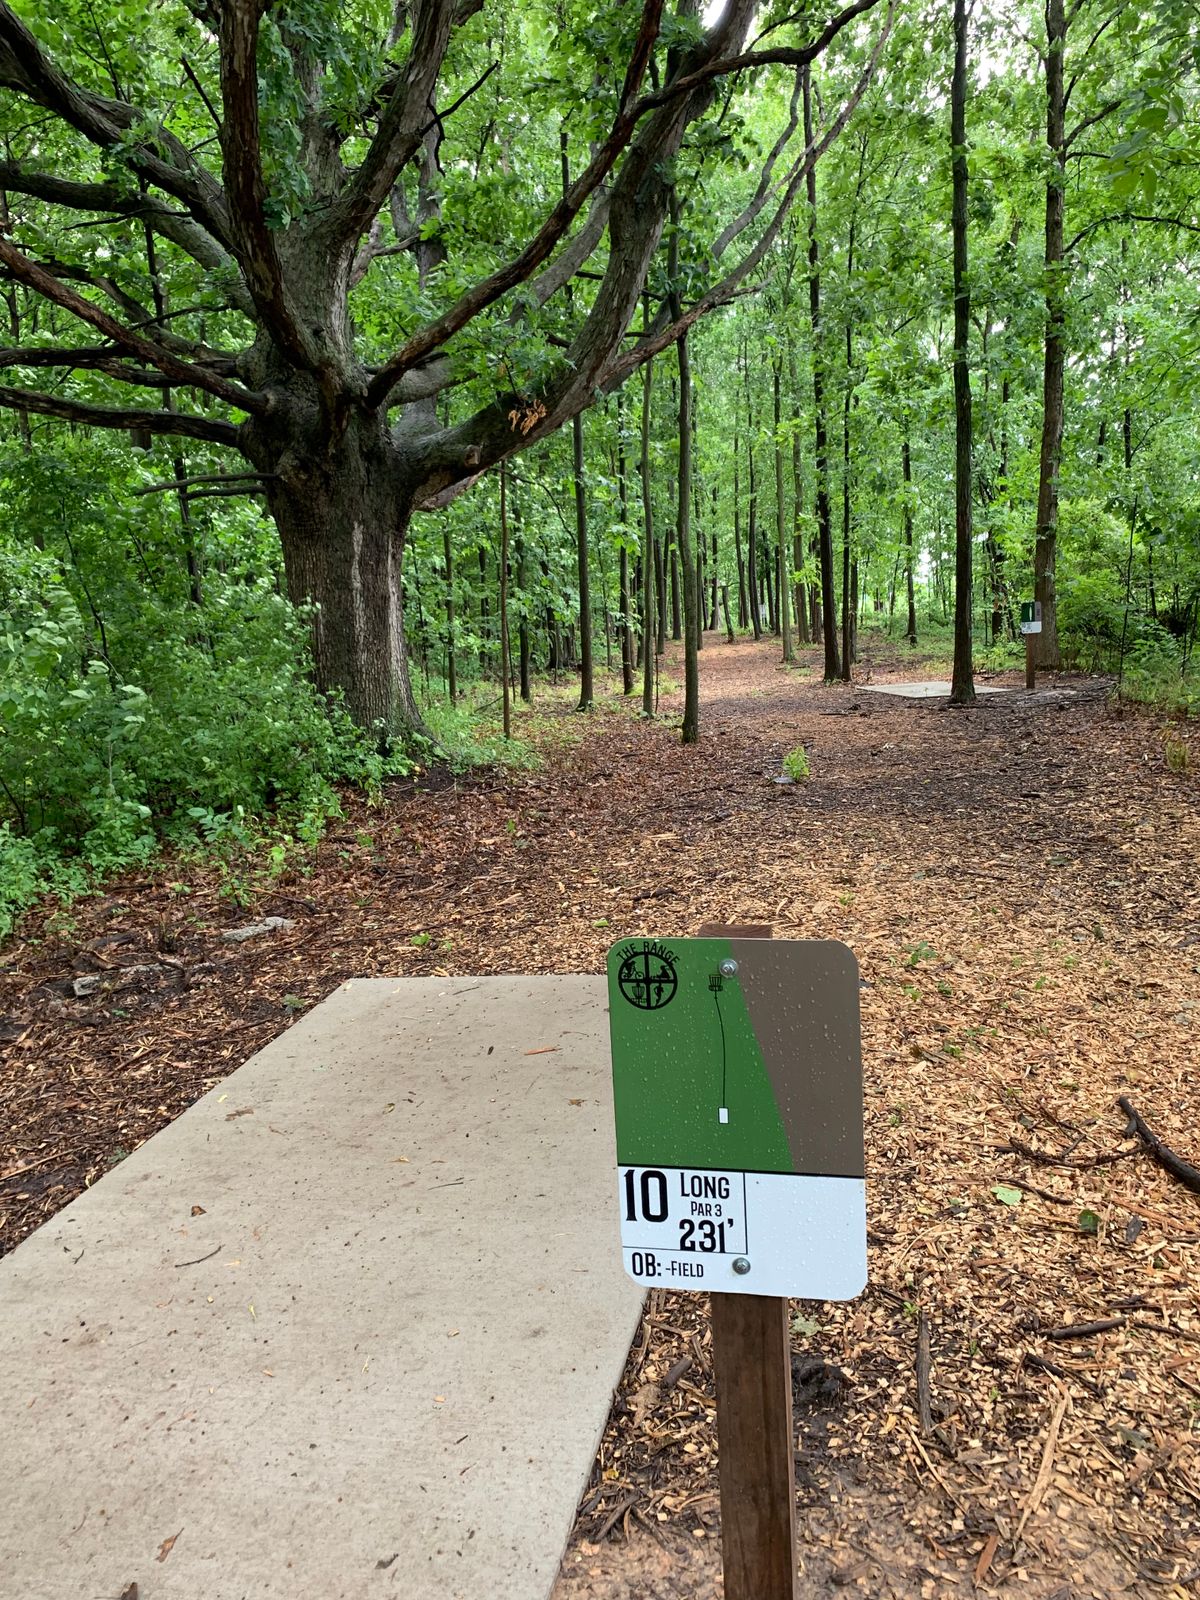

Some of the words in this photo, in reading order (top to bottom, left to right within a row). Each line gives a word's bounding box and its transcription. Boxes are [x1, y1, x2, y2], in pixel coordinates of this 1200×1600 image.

[616, 943, 636, 961] THE
[643, 941, 681, 964] RANGE
[624, 1169, 669, 1223] 10
[680, 1172, 730, 1199] LONG
[690, 1201, 712, 1217] PAR
[714, 1204, 722, 1217] 3
[678, 1218, 734, 1253] 231'
[631, 1252, 662, 1277] OB:
